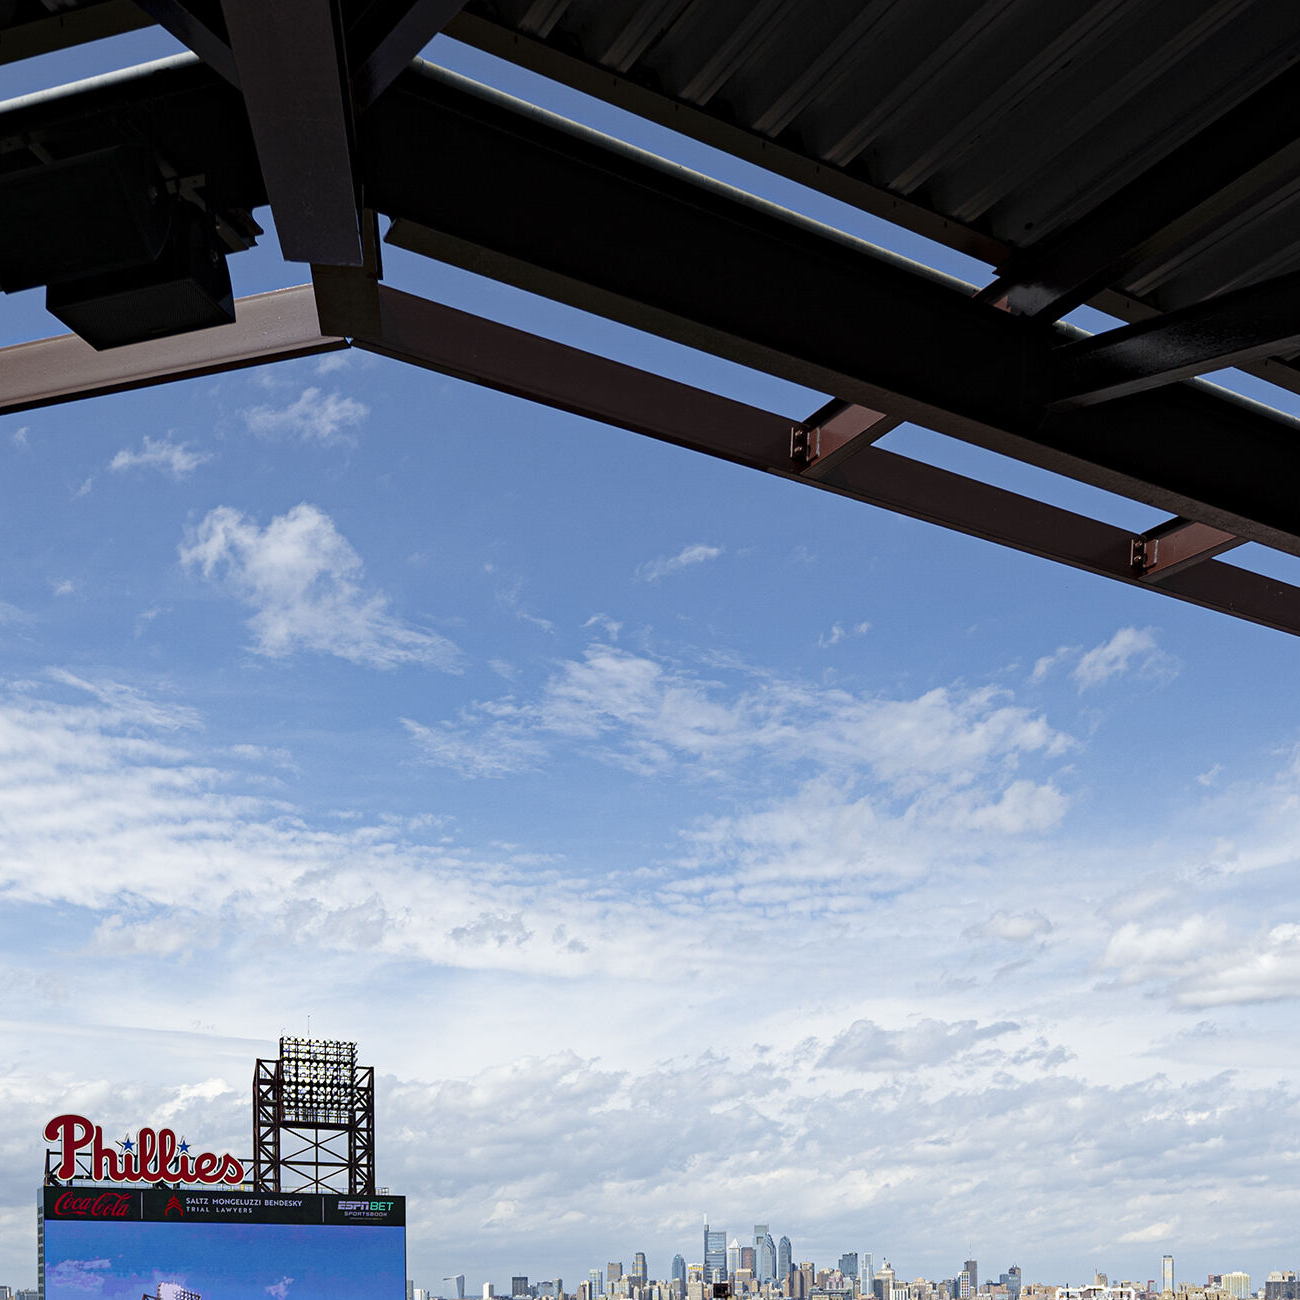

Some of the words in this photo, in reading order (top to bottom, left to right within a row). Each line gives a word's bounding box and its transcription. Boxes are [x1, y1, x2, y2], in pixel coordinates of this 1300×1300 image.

[42, 1114, 246, 1185] Phillies
[212, 1198, 262, 1206] MONGELUZZI
[264, 1199, 302, 1207] BENDESKY
